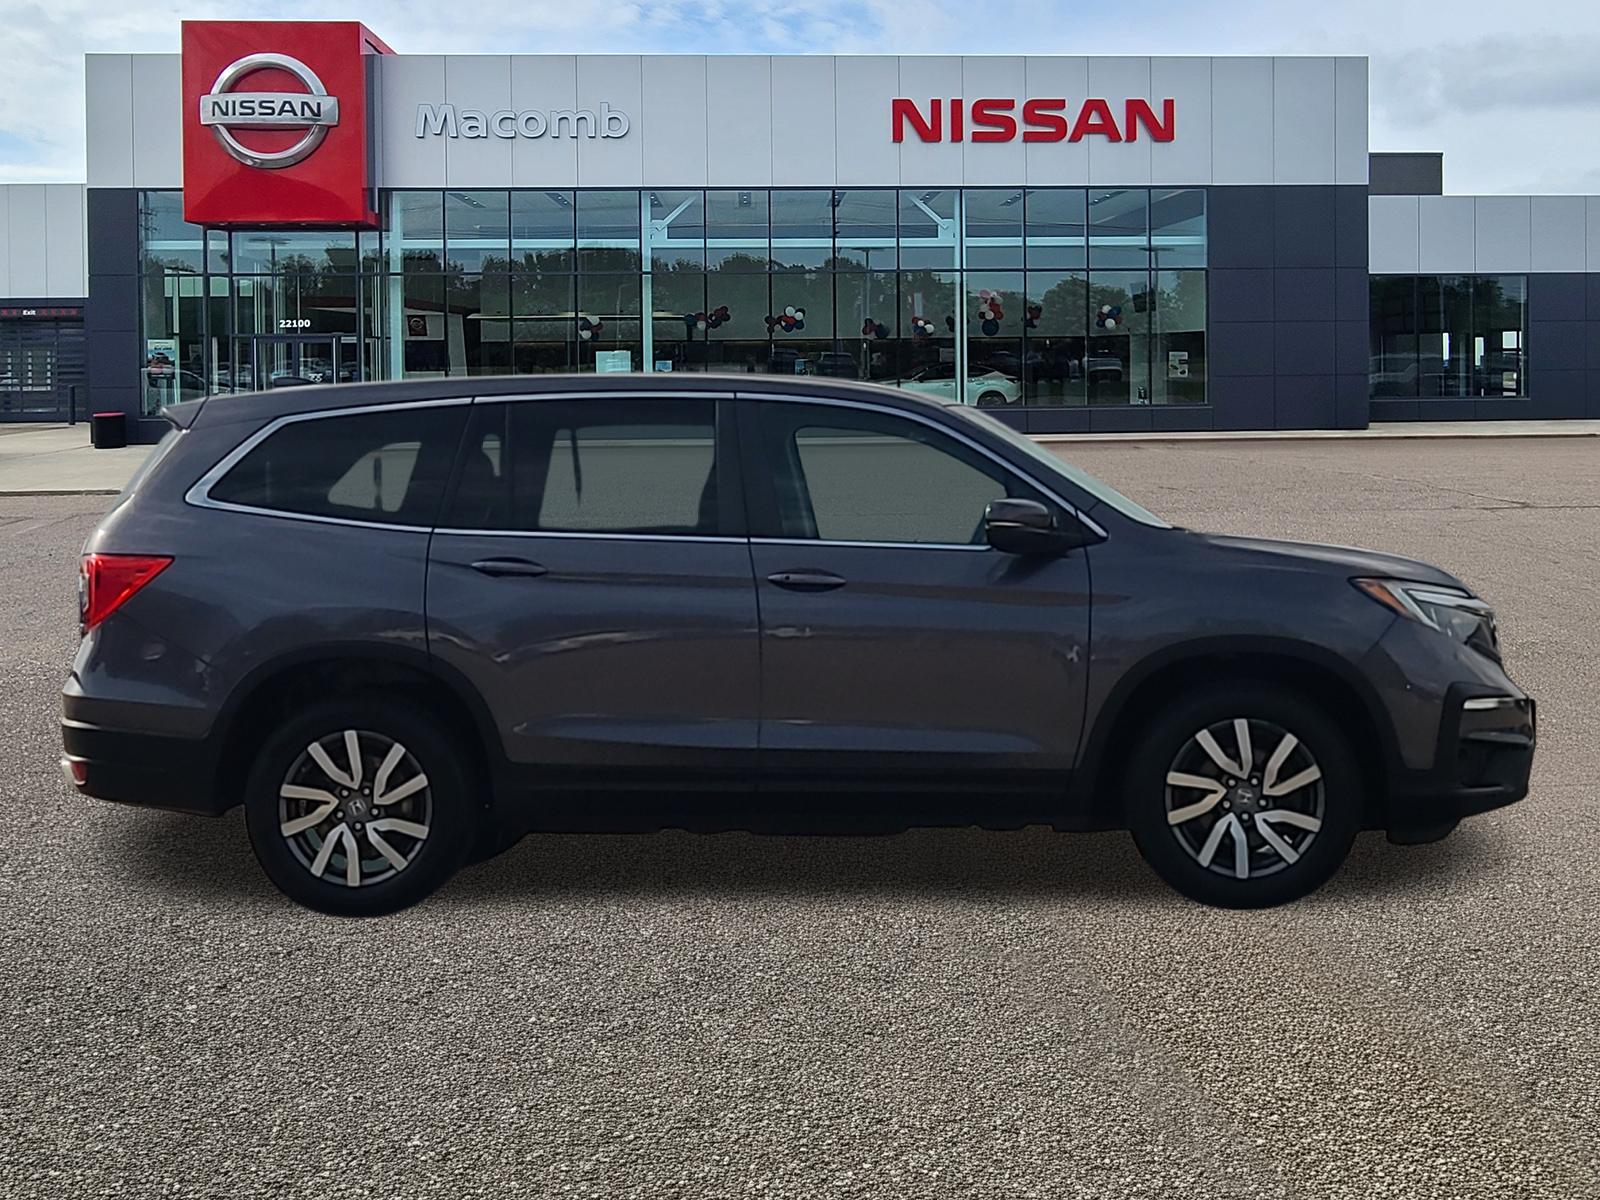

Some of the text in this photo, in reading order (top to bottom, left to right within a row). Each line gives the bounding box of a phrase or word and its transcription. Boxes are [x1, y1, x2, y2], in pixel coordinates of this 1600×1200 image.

[212, 100, 322, 117] NISSAN
[416, 102, 630, 139] Macomb
[892, 98, 1175, 143] NISSAN
[280, 319, 311, 328] 22100
